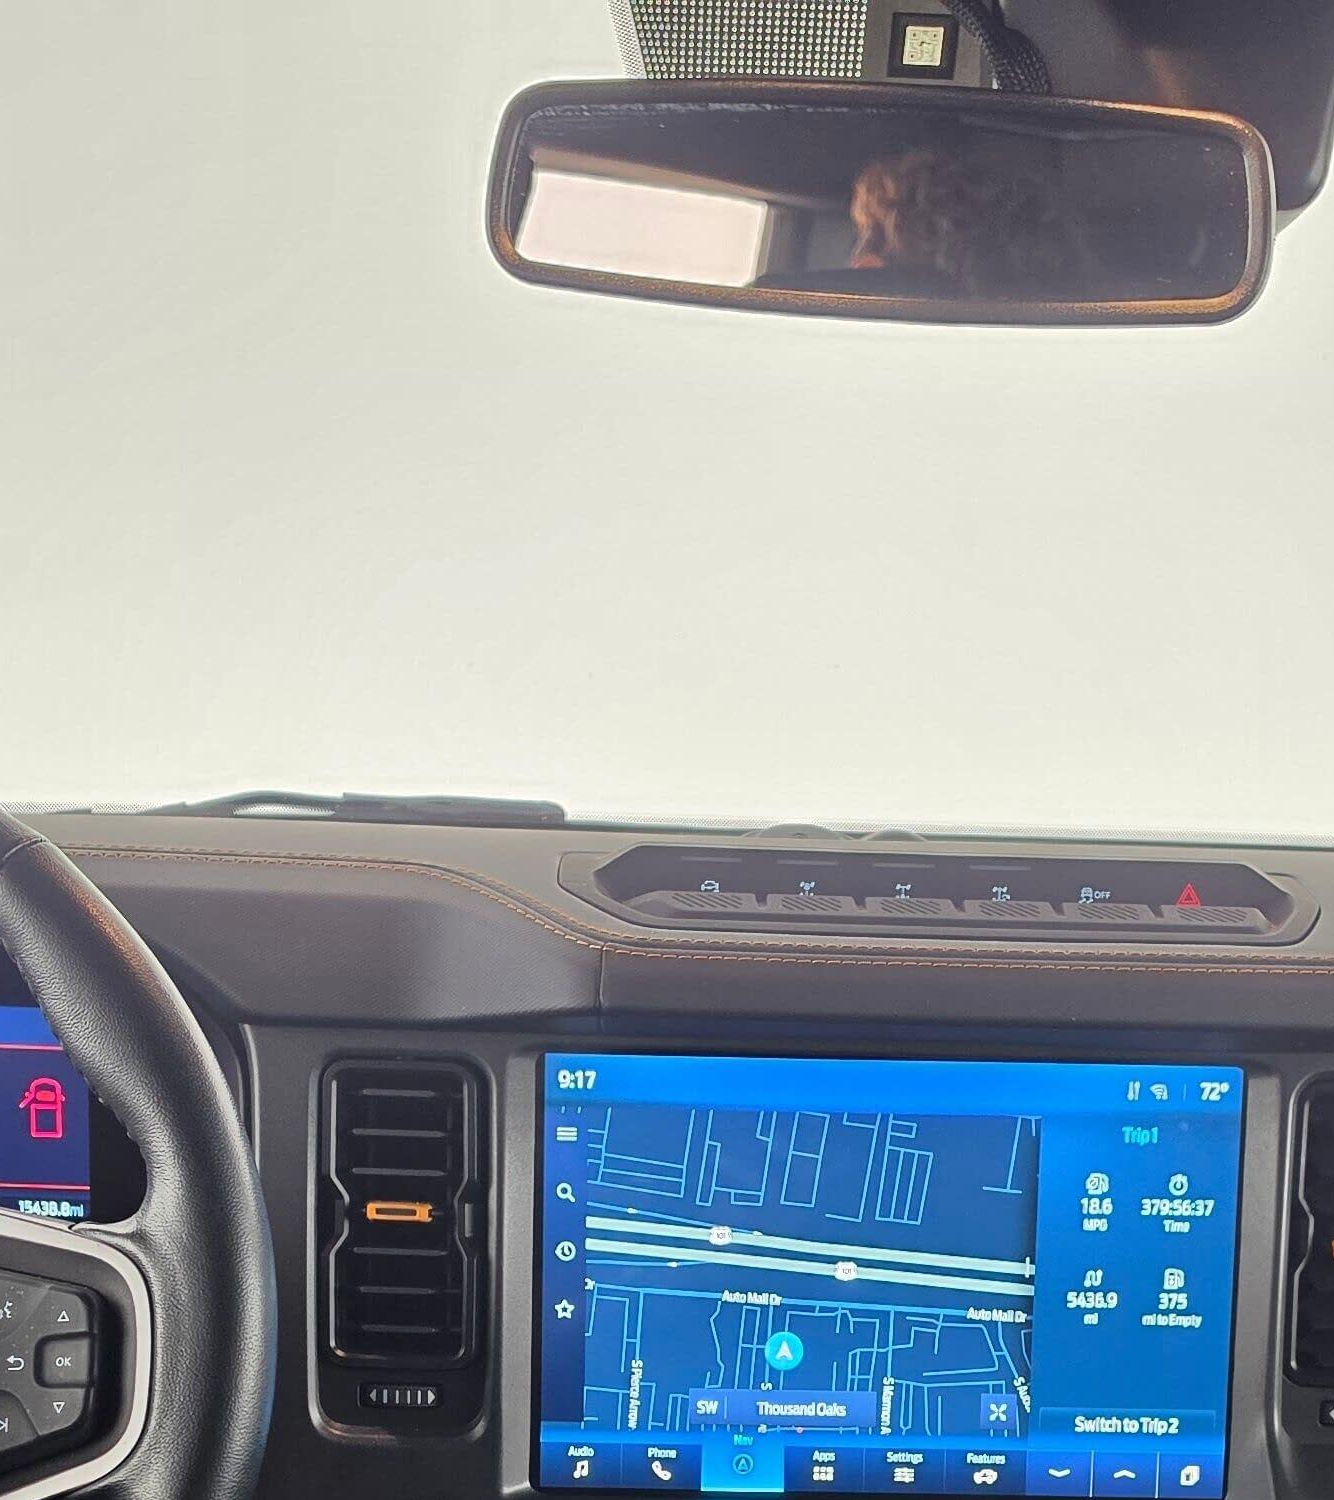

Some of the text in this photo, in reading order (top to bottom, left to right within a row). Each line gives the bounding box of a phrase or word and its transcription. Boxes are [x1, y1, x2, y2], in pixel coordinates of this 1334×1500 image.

[1094, 890, 1111, 900] OFF
[557, 1069, 597, 1090] 9:17
[1200, 1081, 1229, 1101] 72°
[1122, 1126, 1159, 1146] Trip 1
[1080, 1198, 1113, 1216] 18.6
[1140, 1198, 1215, 1217] 379:56:37
[1082, 1218, 1108, 1232] MPG
[1163, 1219, 1190, 1233] Time
[722, 1290, 783, 1306] Auto Mall Dr
[1067, 1292, 1118, 1309] 5436.9
[1158, 1293, 1188, 1310] 375
[967, 1306, 1028, 1324] Auto Mall Dr
[1083, 1313, 1099, 1325] mi
[1141, 1314, 1202, 1328] mi to Empty
[55, 1356, 72, 1367] OK
[882, 1377, 894, 1385] S
[1013, 1376, 1026, 1386] S
[696, 1400, 847, 1417] SW Thousand Oaks
[1074, 1416, 1179, 1436] Switch to Trip 2
[733, 1434, 753, 1446] Nav
[567, 1445, 595, 1457] Audio
[647, 1447, 677, 1459] Phone
[813, 1450, 835, 1462] Apps
[886, 1451, 923, 1464] Settings
[967, 1452, 1006, 1464] Features
